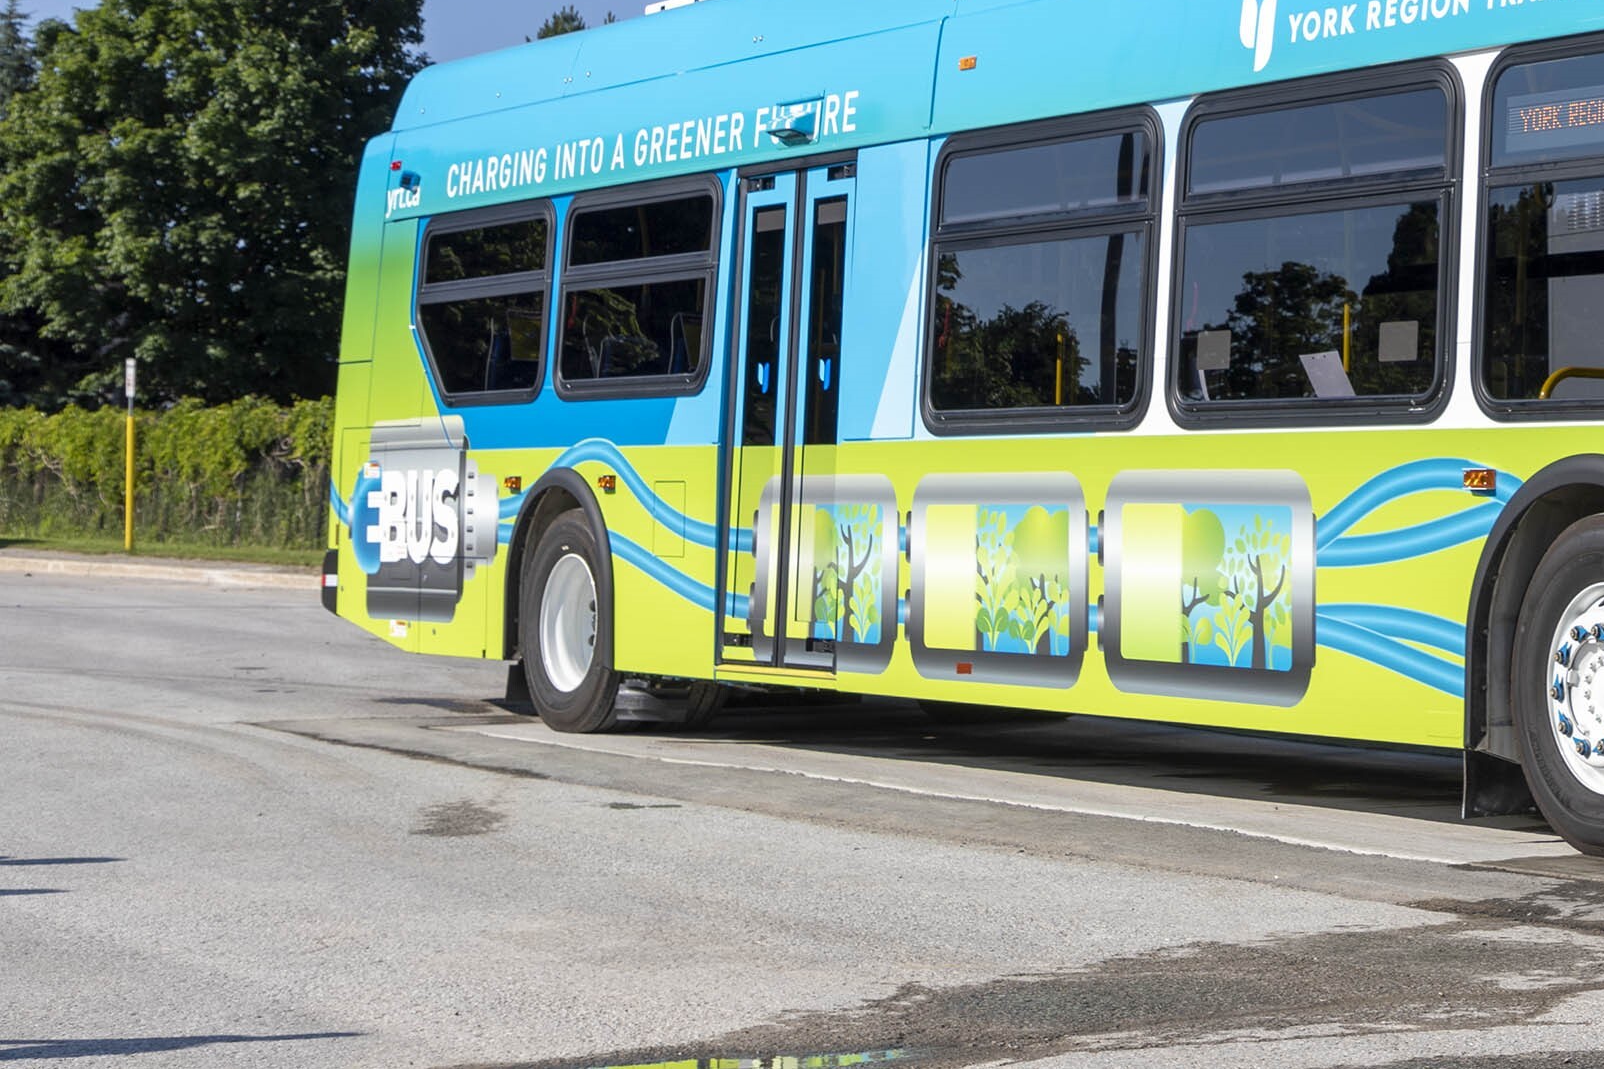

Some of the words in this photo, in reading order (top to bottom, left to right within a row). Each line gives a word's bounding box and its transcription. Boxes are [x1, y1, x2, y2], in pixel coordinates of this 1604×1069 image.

[1288, 3, 1357, 43] YORK
[1519, 104, 1562, 133] YORK
[446, 147, 547, 198] CHARGING
[554, 137, 604, 180] INTO
[610, 133, 625, 171] A
[633, 112, 745, 166] GREENER
